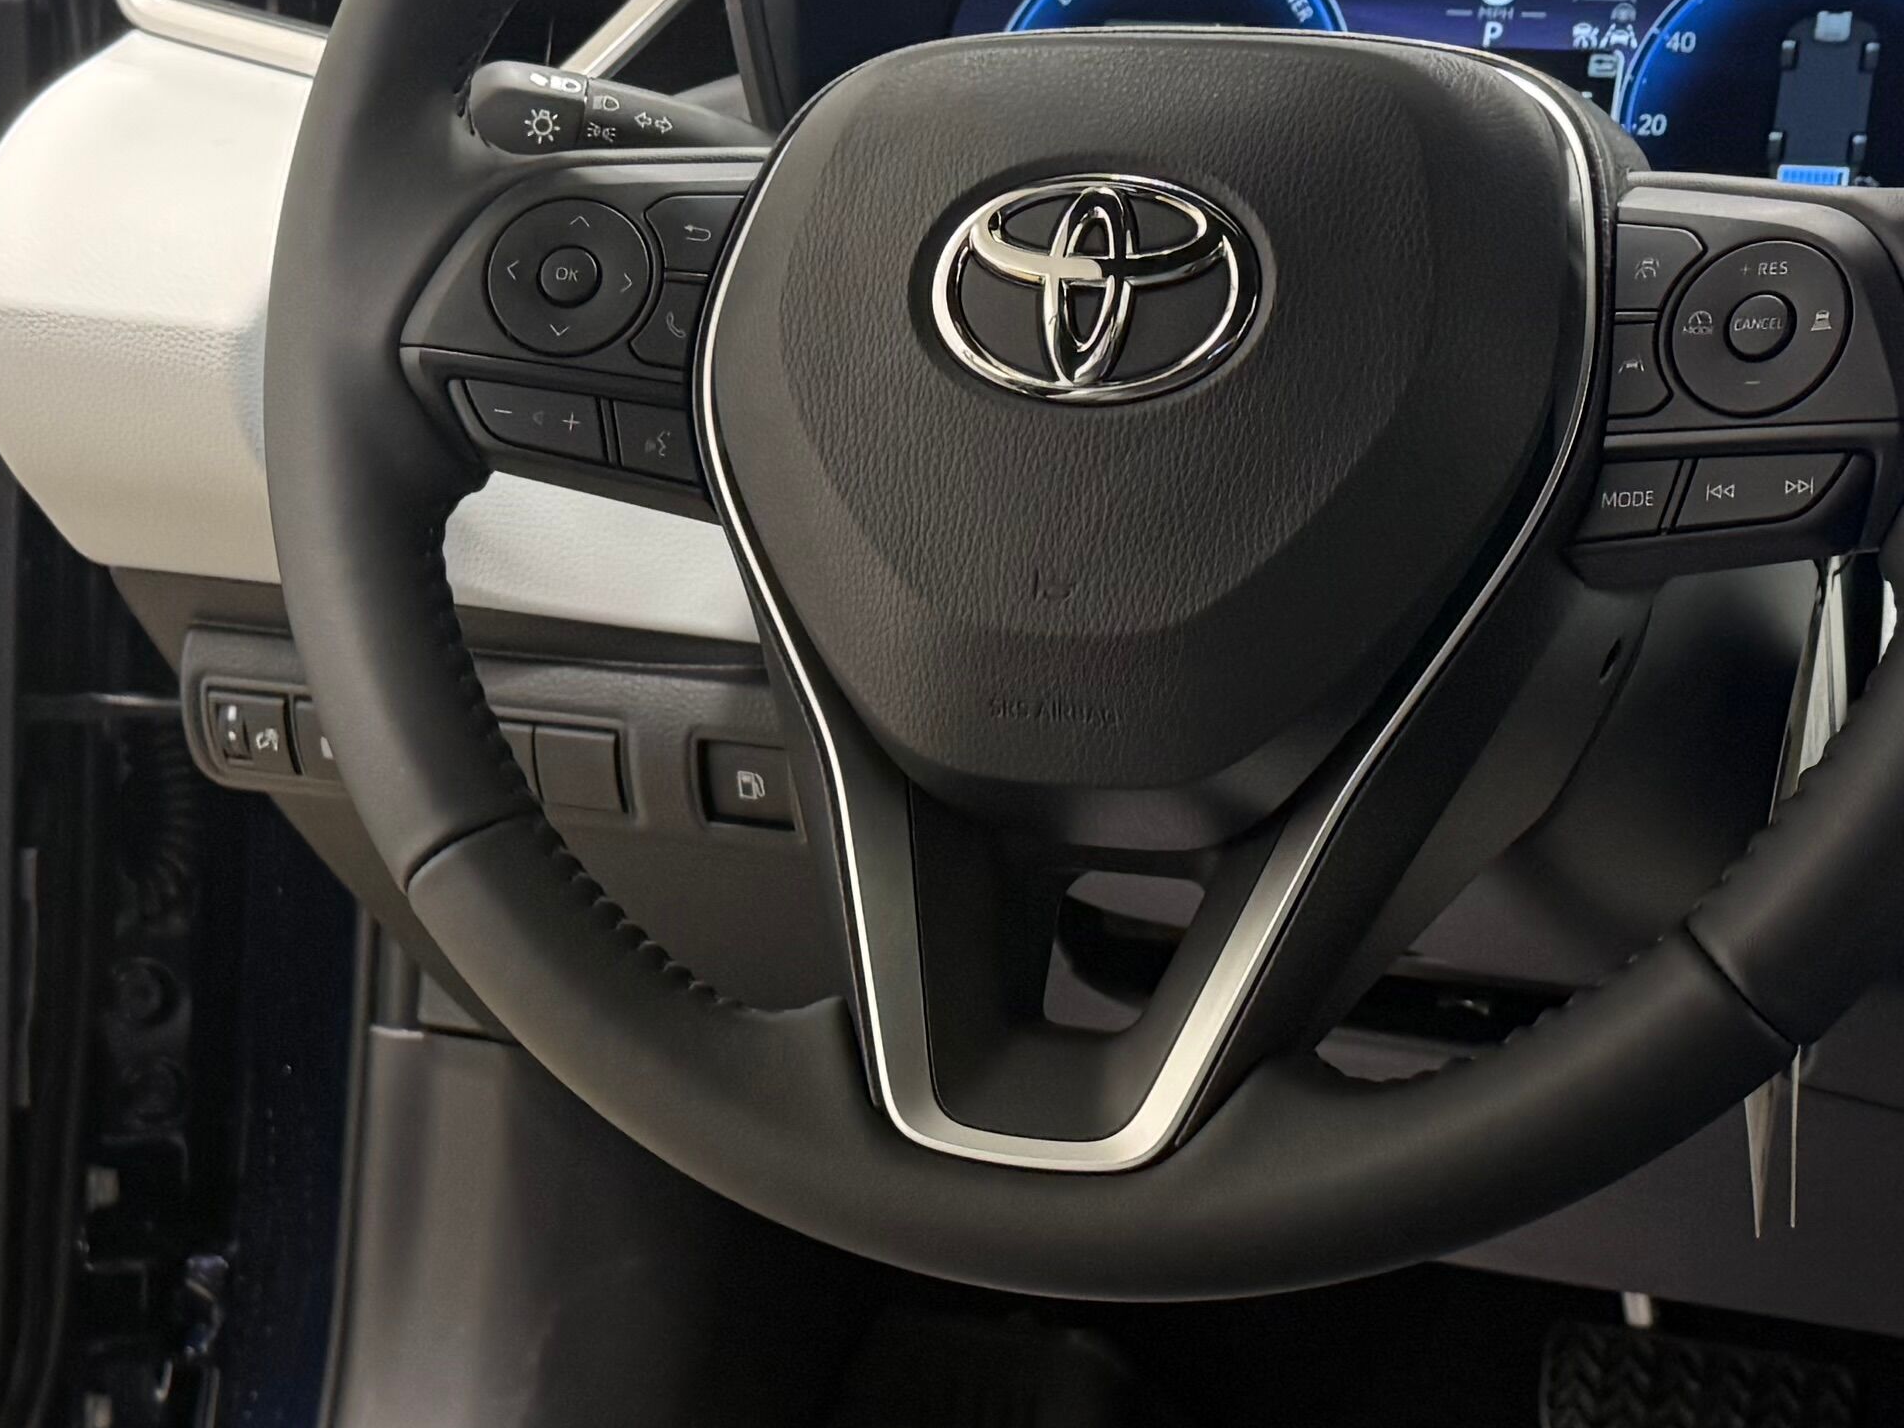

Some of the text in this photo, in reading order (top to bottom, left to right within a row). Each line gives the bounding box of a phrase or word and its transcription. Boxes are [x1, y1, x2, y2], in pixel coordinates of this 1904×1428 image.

[1482, 21, 1504, 48] P
[1665, 30, 1697, 54] 40
[1636, 113, 1668, 136] 20
[555, 267, 579, 282] OK
[1758, 260, 1788, 275] RES
[1733, 317, 1784, 331] CANCEL
[1601, 490, 1655, 508] MODE
